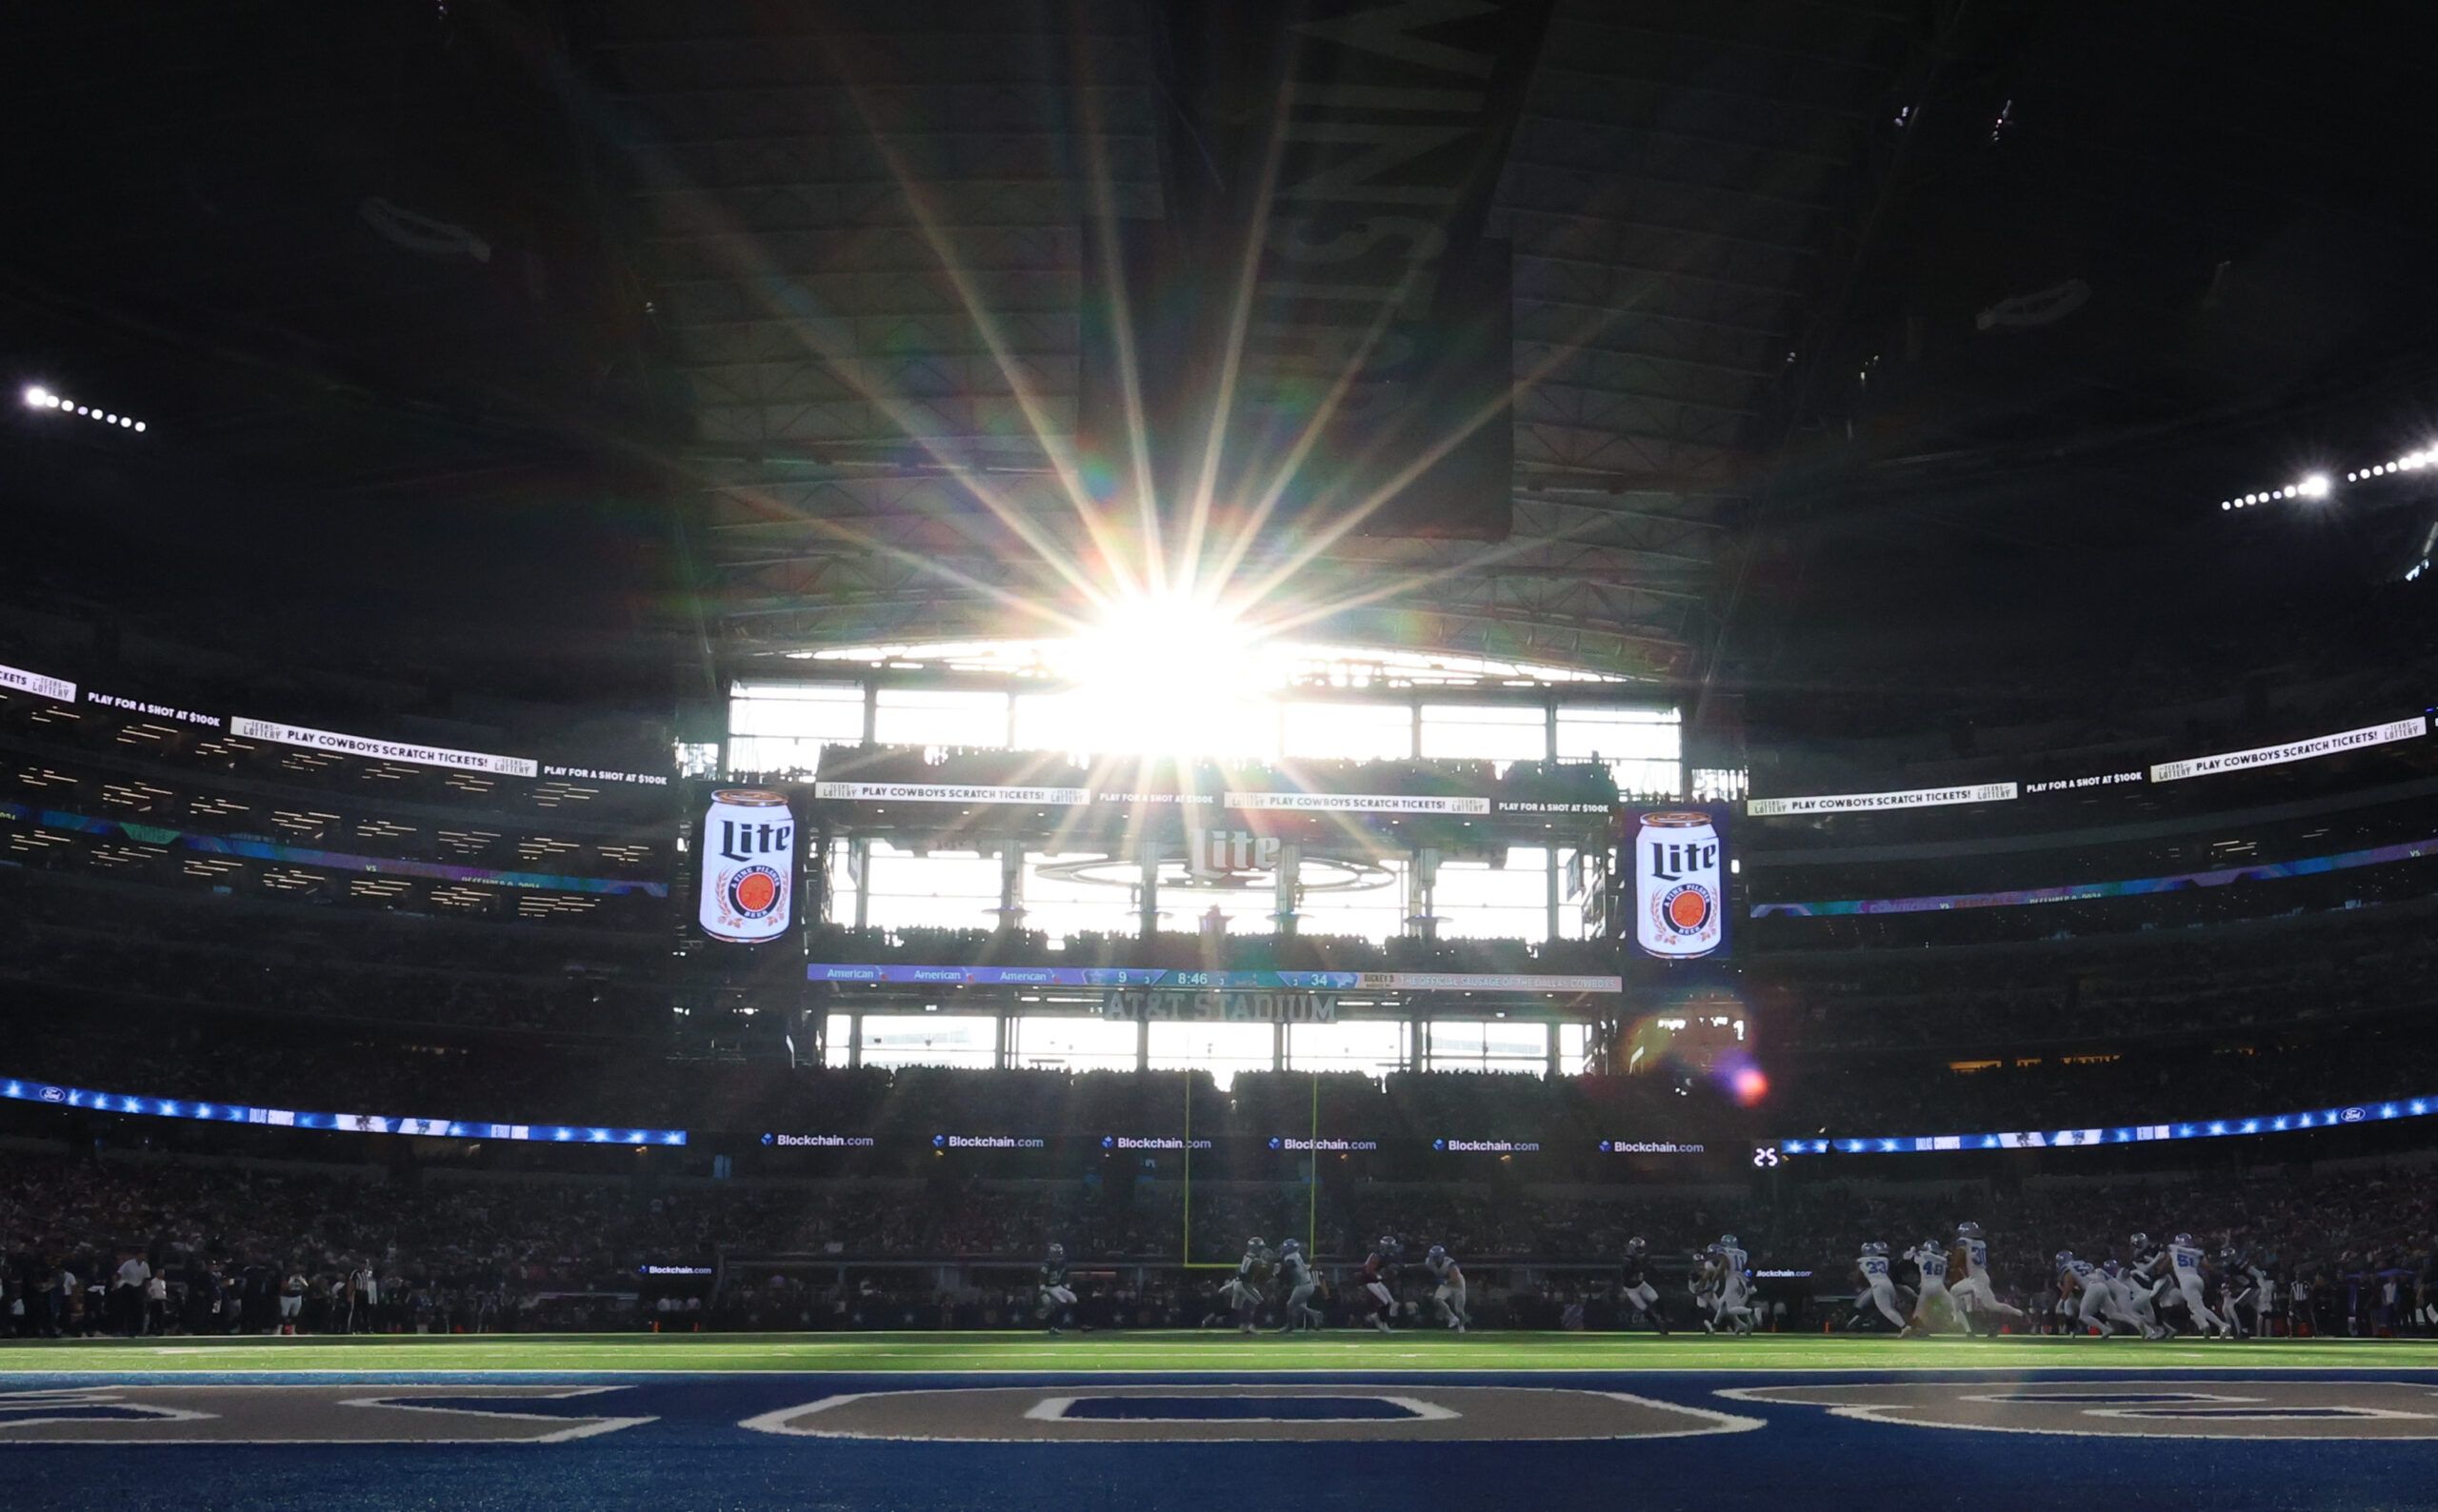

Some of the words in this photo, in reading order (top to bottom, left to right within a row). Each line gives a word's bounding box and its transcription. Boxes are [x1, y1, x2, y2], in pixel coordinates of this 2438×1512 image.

[0, 671, 27, 685] KETS
[88, 692, 113, 705] PLAY
[115, 698, 136, 710] FOR
[138, 703, 146, 712] A
[148, 705, 174, 717] SHOT
[176, 710, 189, 720] AT
[190, 712, 220, 726] $100K
[288, 730, 315, 743] PLAY
[319, 736, 379, 753] COWBOYS
[382, 746, 434, 761] SCRATCH
[438, 752, 489, 767] TICKETS!
[2197, 760, 2221, 771] PLAY
[2224, 750, 2280, 766] COWBOYS
[2283, 741, 2328, 757] SCRATCH
[2332, 731, 2377, 747] TICKETS!
[544, 766, 567, 776] PLAY
[569, 768, 589, 778] FOR
[590, 770, 597, 779] A
[598, 770, 624, 781] SHOT
[626, 773, 636, 782] AT
[638, 774, 667, 785] $100K
[2027, 783, 2048, 793] PLAY
[2048, 781, 2068, 790] FOR
[2068, 780, 2075, 788] A
[2076, 776, 2100, 787] SHOT
[2102, 775, 2112, 784] AT
[2113, 771, 2143, 784] $100K
[862, 787, 888, 796] PLAY
[890, 787, 946, 797] COWBOYS
[949, 789, 995, 799] SCRATCH
[999, 790, 1044, 800] TICKETS!
[1792, 801, 1815, 809] PLAY
[1819, 798, 1873, 808] COWBOYS
[1877, 793, 1922, 806] SCRATCH
[1926, 790, 1970, 801] TICKETS!
[1270, 797, 1294, 806] PLAY
[1297, 798, 1350, 807] COWBOYS
[1353, 799, 1398, 808] SCRATCH
[1402, 800, 1446, 809] TICKETS!
[1520, 803, 1537, 811] FOR
[1547, 804, 1569, 812] SHOT
[1571, 804, 1581, 812] AT
[1582, 804, 1609, 813] $100K
[719, 820, 790, 862] Lite
[1189, 828, 1280, 879] Lite
[1649, 842, 1716, 881] Lite
[828, 969, 873, 979] American
[914, 970, 961, 980] American
[1000, 971, 1046, 981] American
[1118, 971, 1127, 983] 9
[1178, 972, 1208, 985] 8:46
[1310, 973, 1328, 986] 34
[1105, 992, 1186, 1021] AT&T
[1194, 992, 1336, 1023] STADIUM
[777, 1134, 873, 1146] Blockchain.com
[949, 1136, 1044, 1147] Blockchain.com
[1117, 1137, 1211, 1149] Blockchain.com
[1448, 1140, 1539, 1151] Blockchain.com
[1614, 1141, 1704, 1153] Blockchain.com
[1754, 1147, 1778, 1166] 25
[649, 1265, 711, 1274] Blockchain.com
